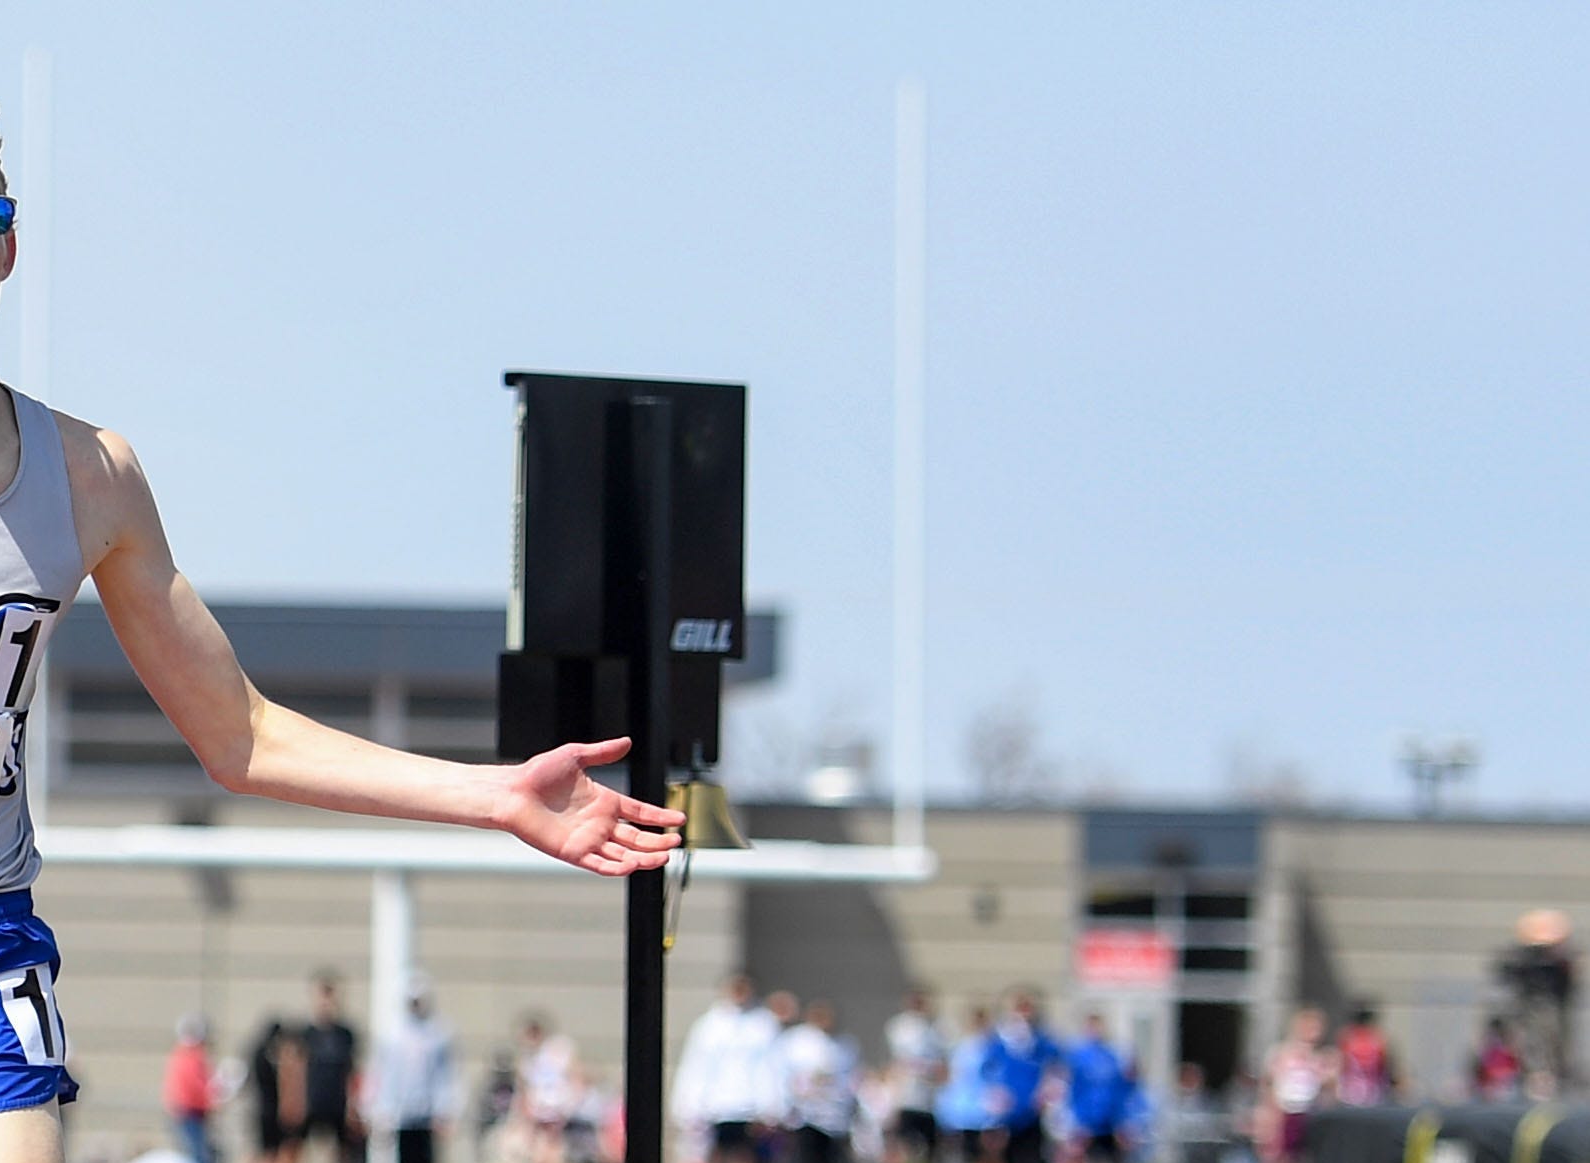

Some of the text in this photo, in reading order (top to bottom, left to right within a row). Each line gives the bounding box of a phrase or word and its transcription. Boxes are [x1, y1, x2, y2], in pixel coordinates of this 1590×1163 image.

[4, 619, 42, 707] 1
[671, 619, 732, 652] GILL
[14, 968, 55, 1058] 1
